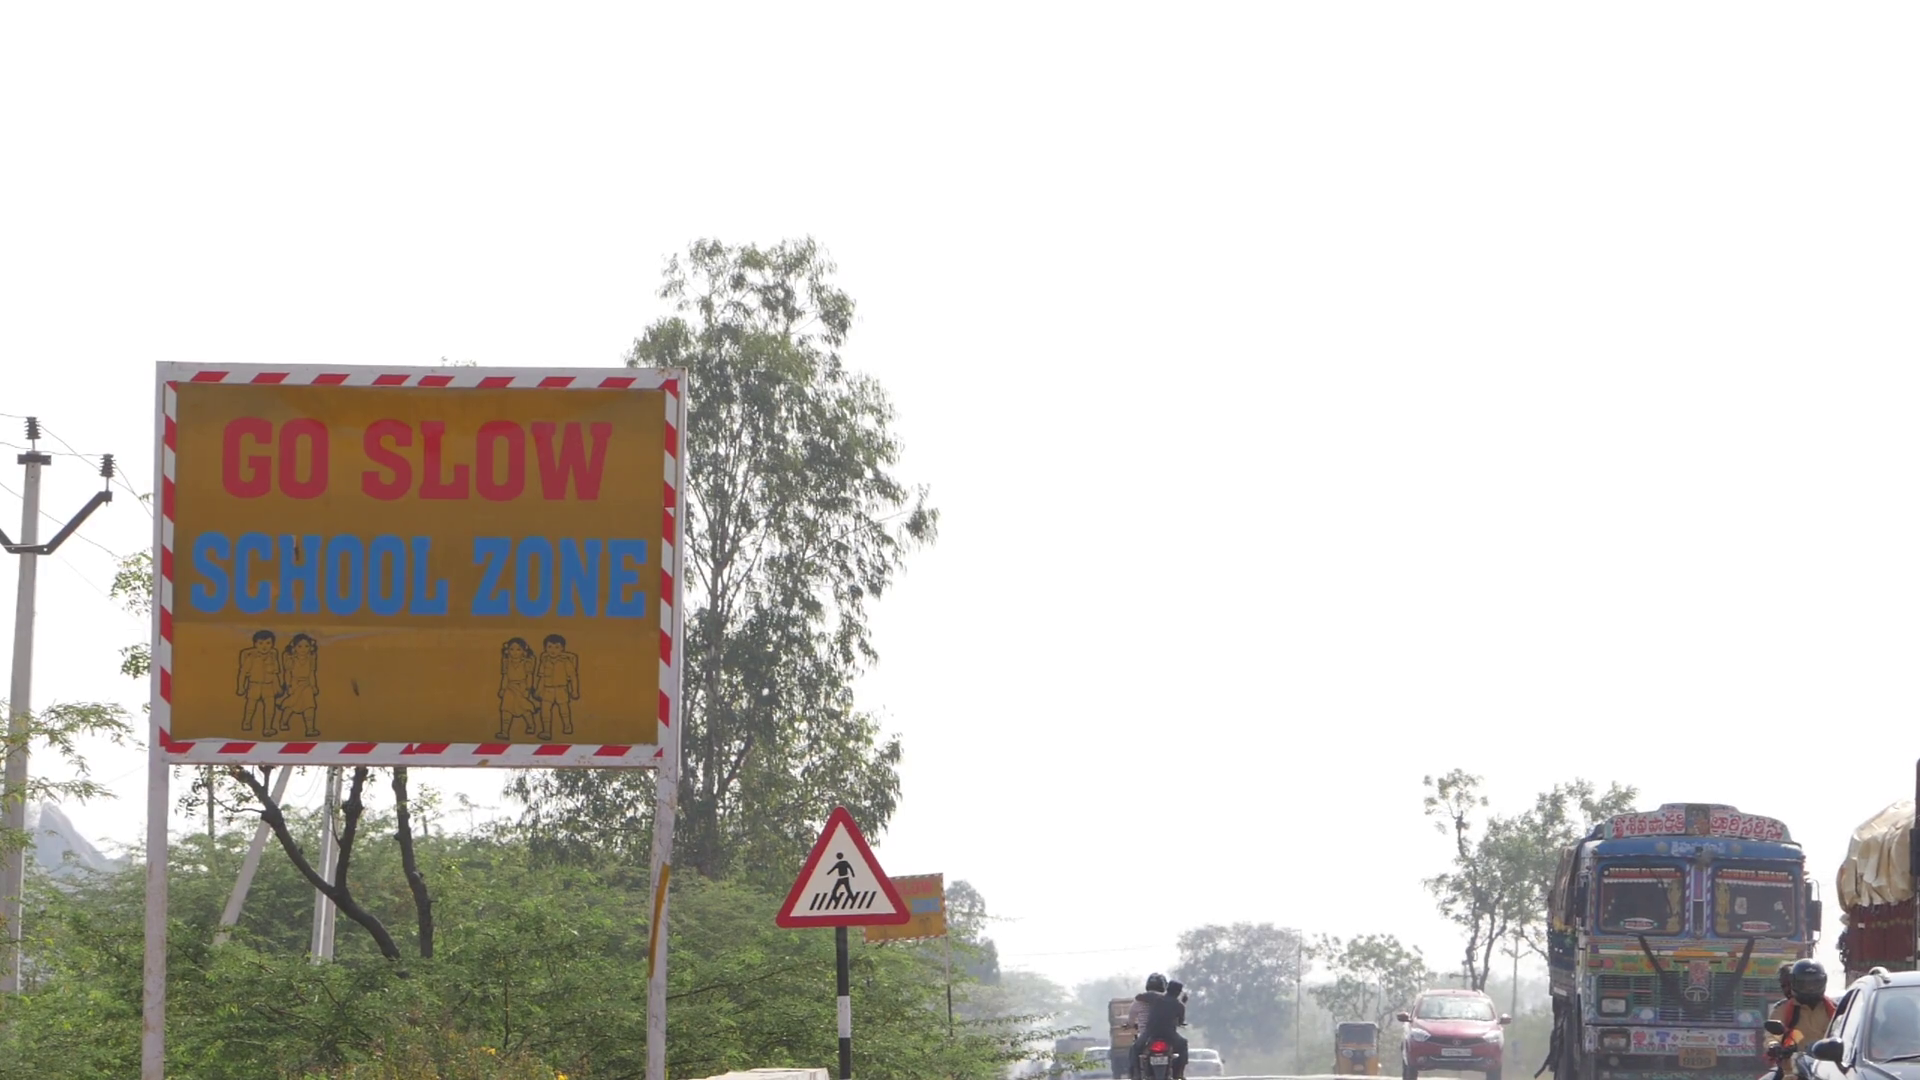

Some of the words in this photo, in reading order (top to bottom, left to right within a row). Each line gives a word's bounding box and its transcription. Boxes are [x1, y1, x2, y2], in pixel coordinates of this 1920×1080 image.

[222, 417, 331, 500] GO
[362, 419, 614, 503] SLOW
[190, 531, 449, 617] SCHOOL
[471, 537, 648, 619] ZONE
